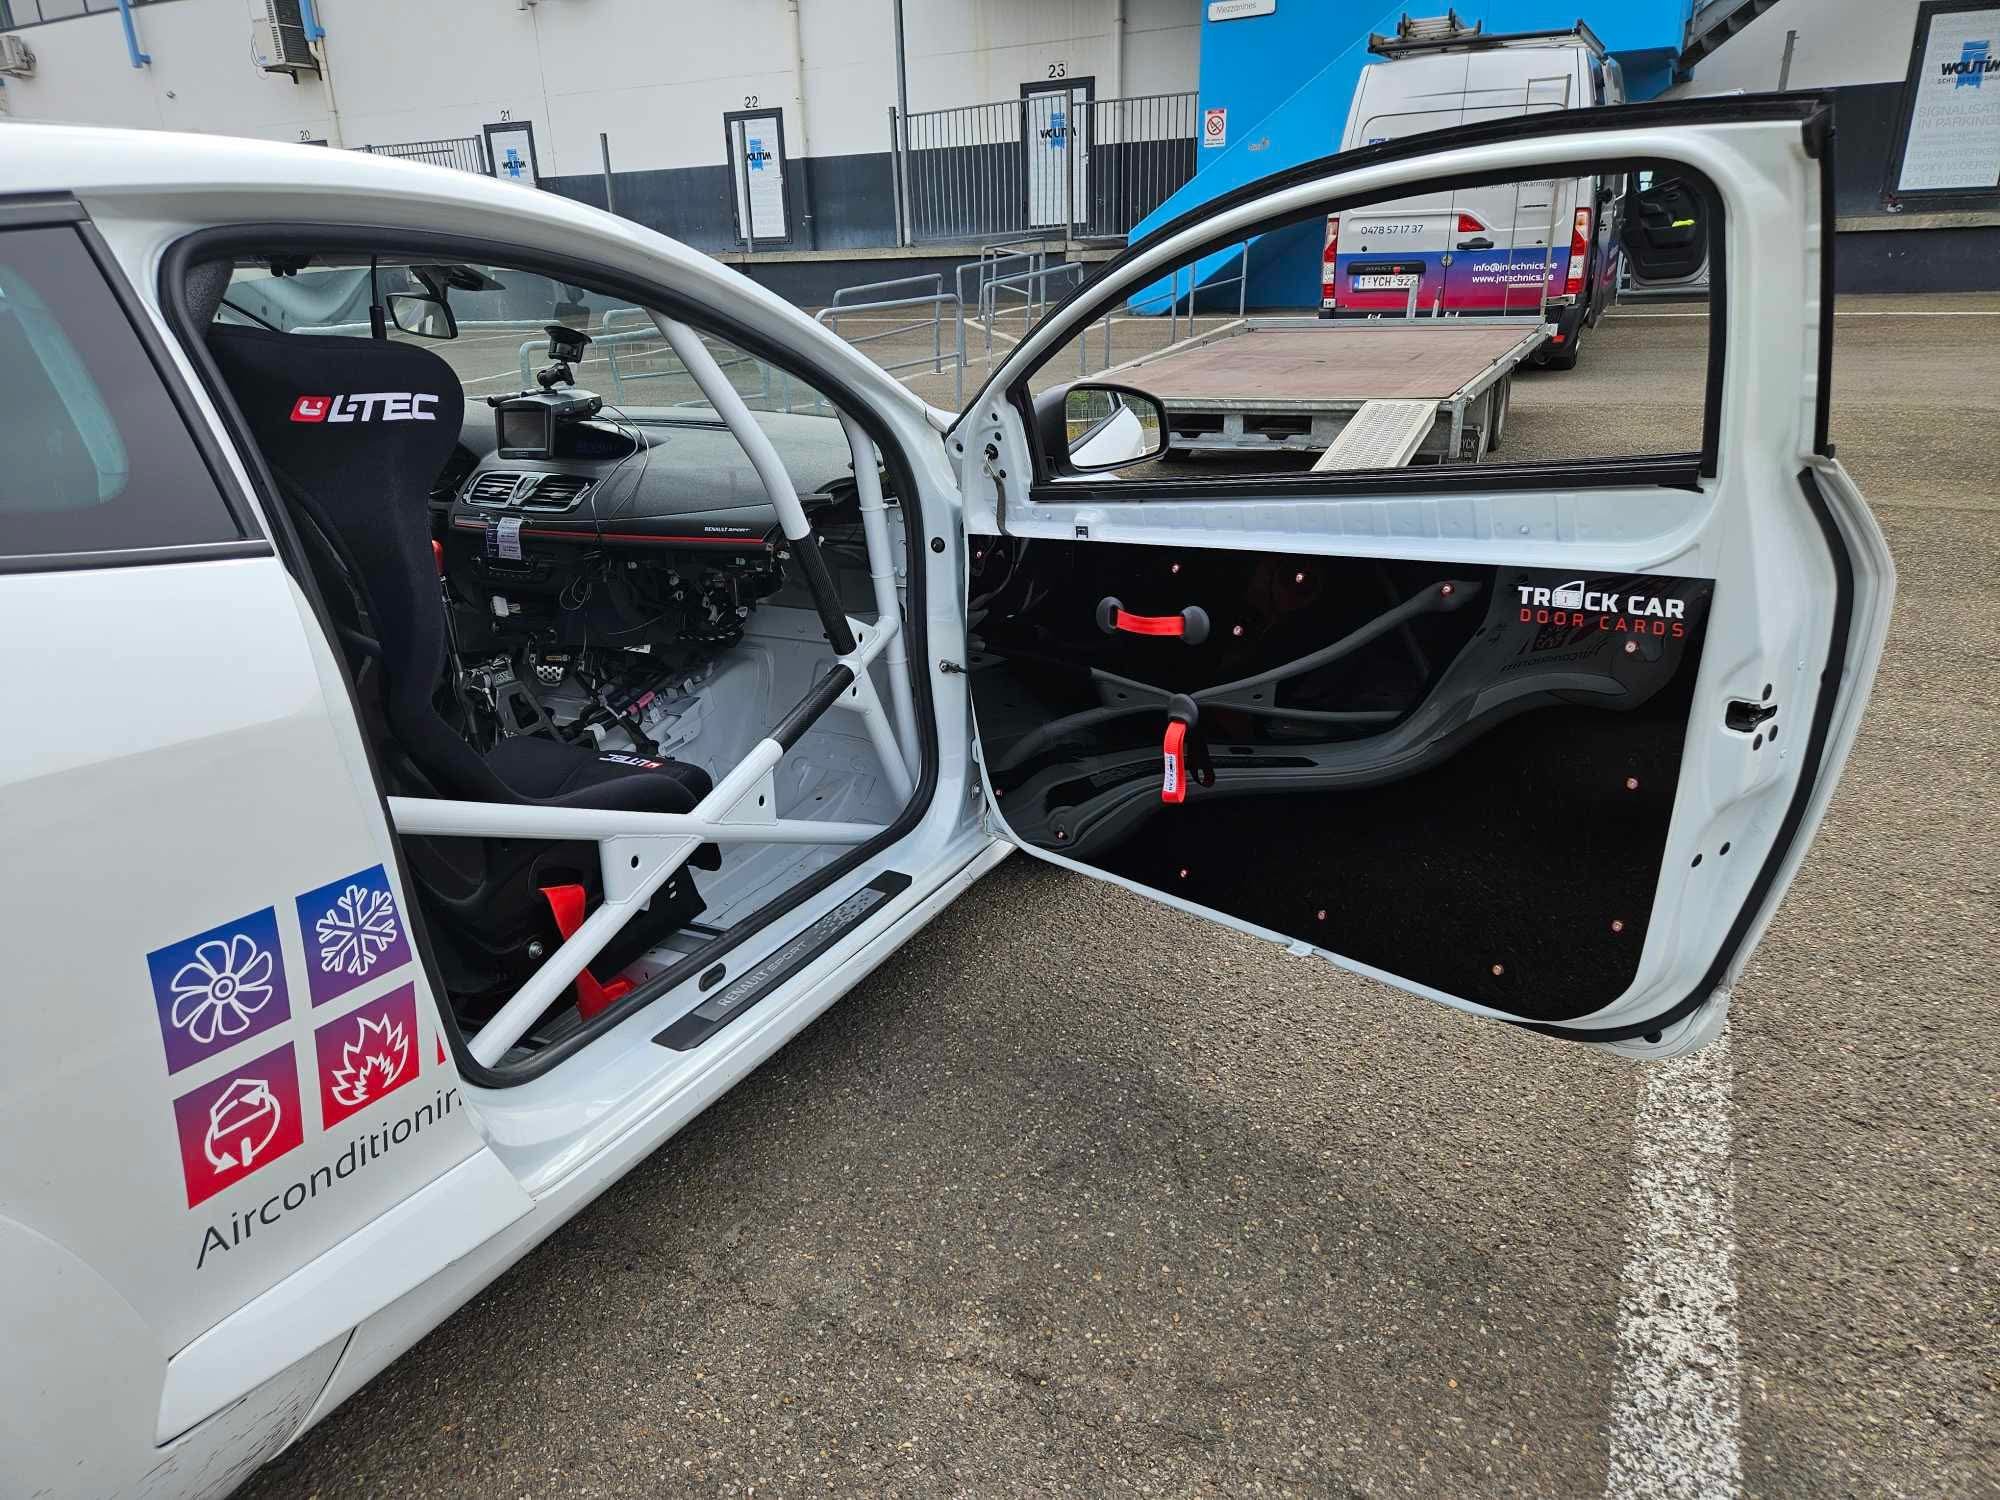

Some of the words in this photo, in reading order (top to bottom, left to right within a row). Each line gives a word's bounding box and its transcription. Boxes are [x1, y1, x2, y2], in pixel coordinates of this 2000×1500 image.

[1048, 63, 1065, 78] 23
[744, 95, 759, 109] 22
[500, 110, 511, 121] 21
[300, 130, 311, 141] 20
[1360, 225, 1385, 235] 0478
[1387, 225, 1398, 234] 57
[1400, 225, 1410, 234] 17
[1411, 224, 1424, 234] 37
[1473, 261, 1558, 273] info@jnechnics.e
[1361, 276, 1417, 287] 1-YCH-92
[1627, 595, 1685, 620] CAR
[1520, 608, 1585, 628] DOOR
[1600, 616, 1685, 638] CARDS
[717, 969, 769, 1007] RENAULT
[767, 940, 807, 972] SPORT
